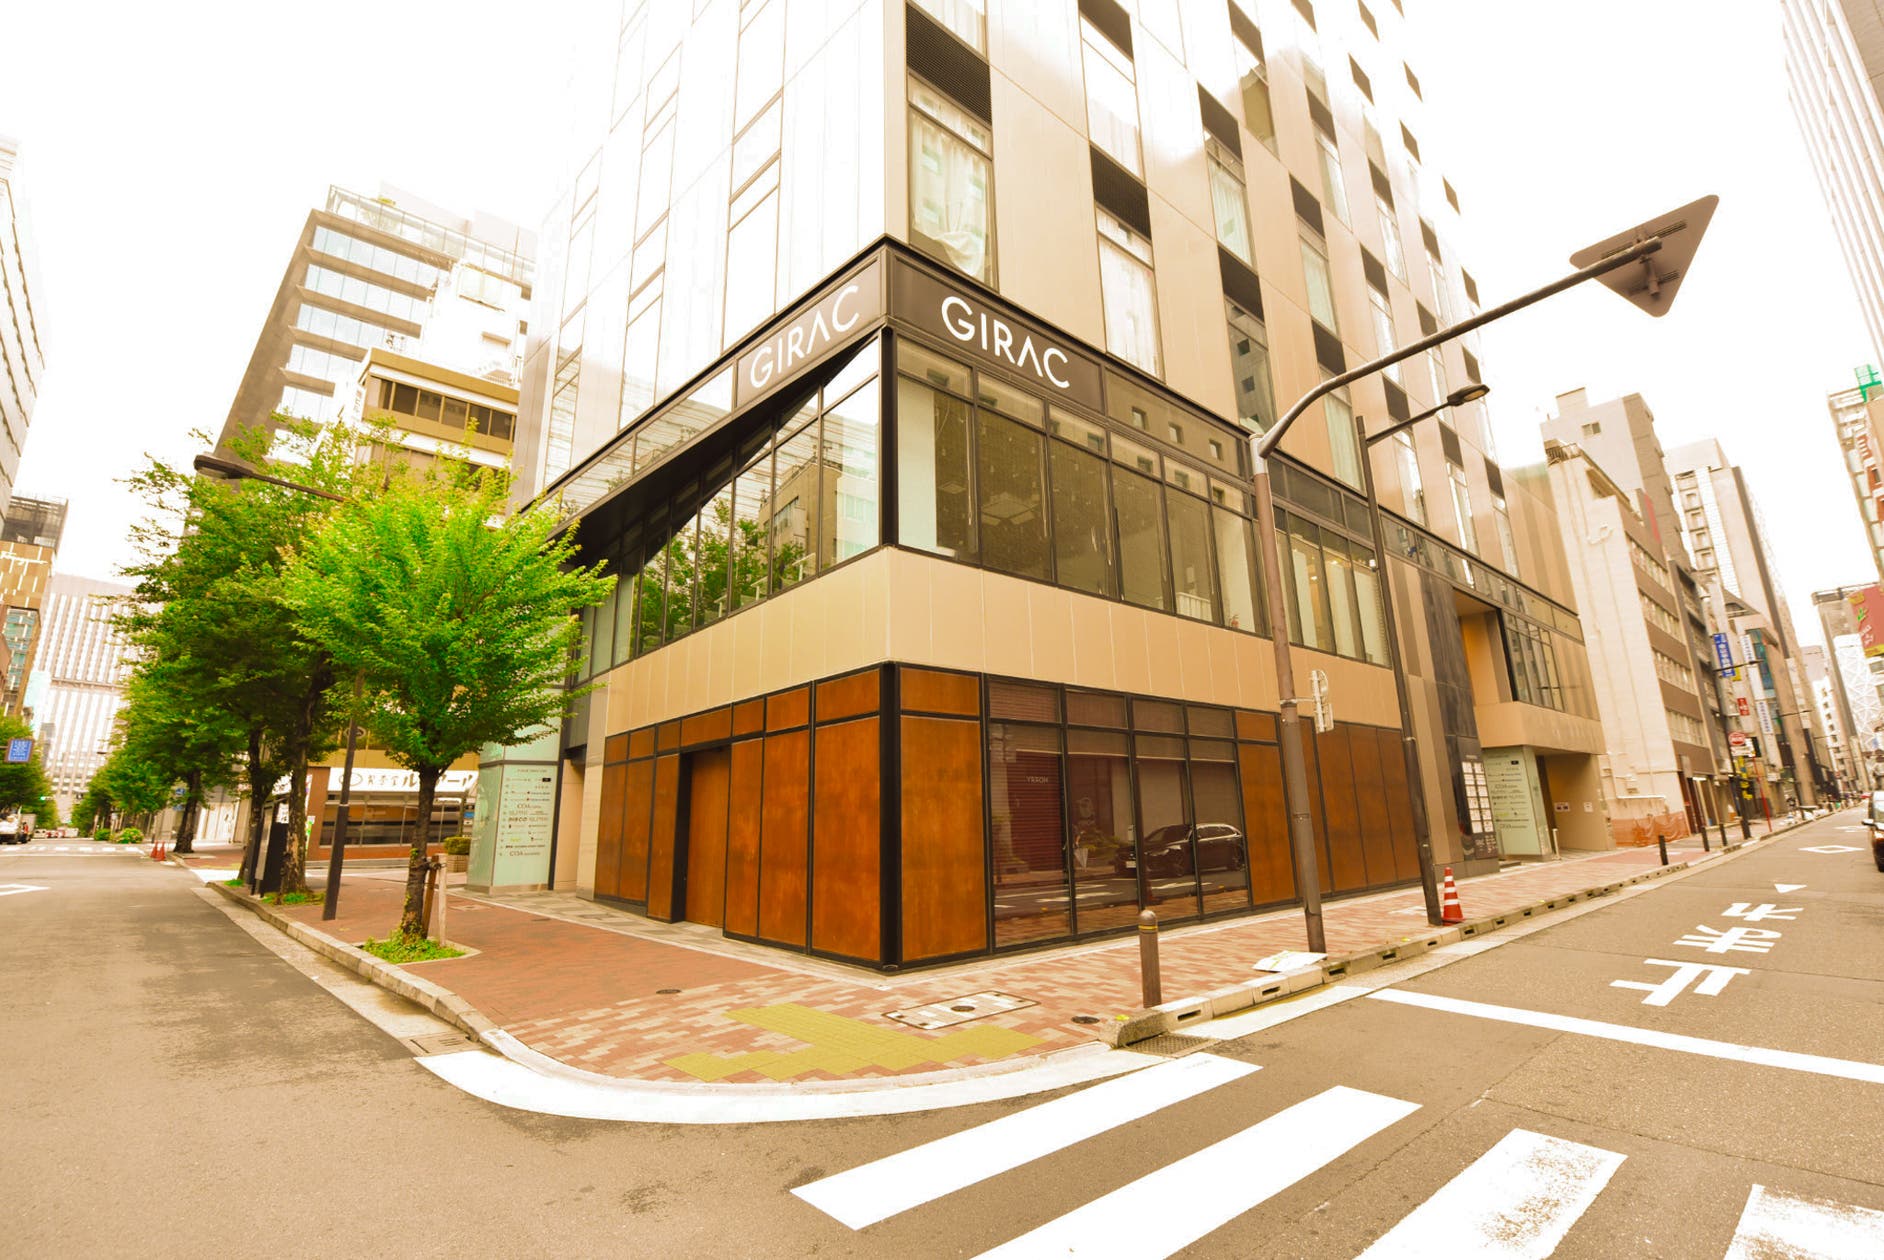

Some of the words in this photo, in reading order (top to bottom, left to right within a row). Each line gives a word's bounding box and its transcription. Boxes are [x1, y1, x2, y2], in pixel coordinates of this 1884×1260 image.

[750, 285, 860, 389] GIRAC
[941, 296, 1071, 389] GIRAC
[1609, 903, 1804, 1007] 止まれ
